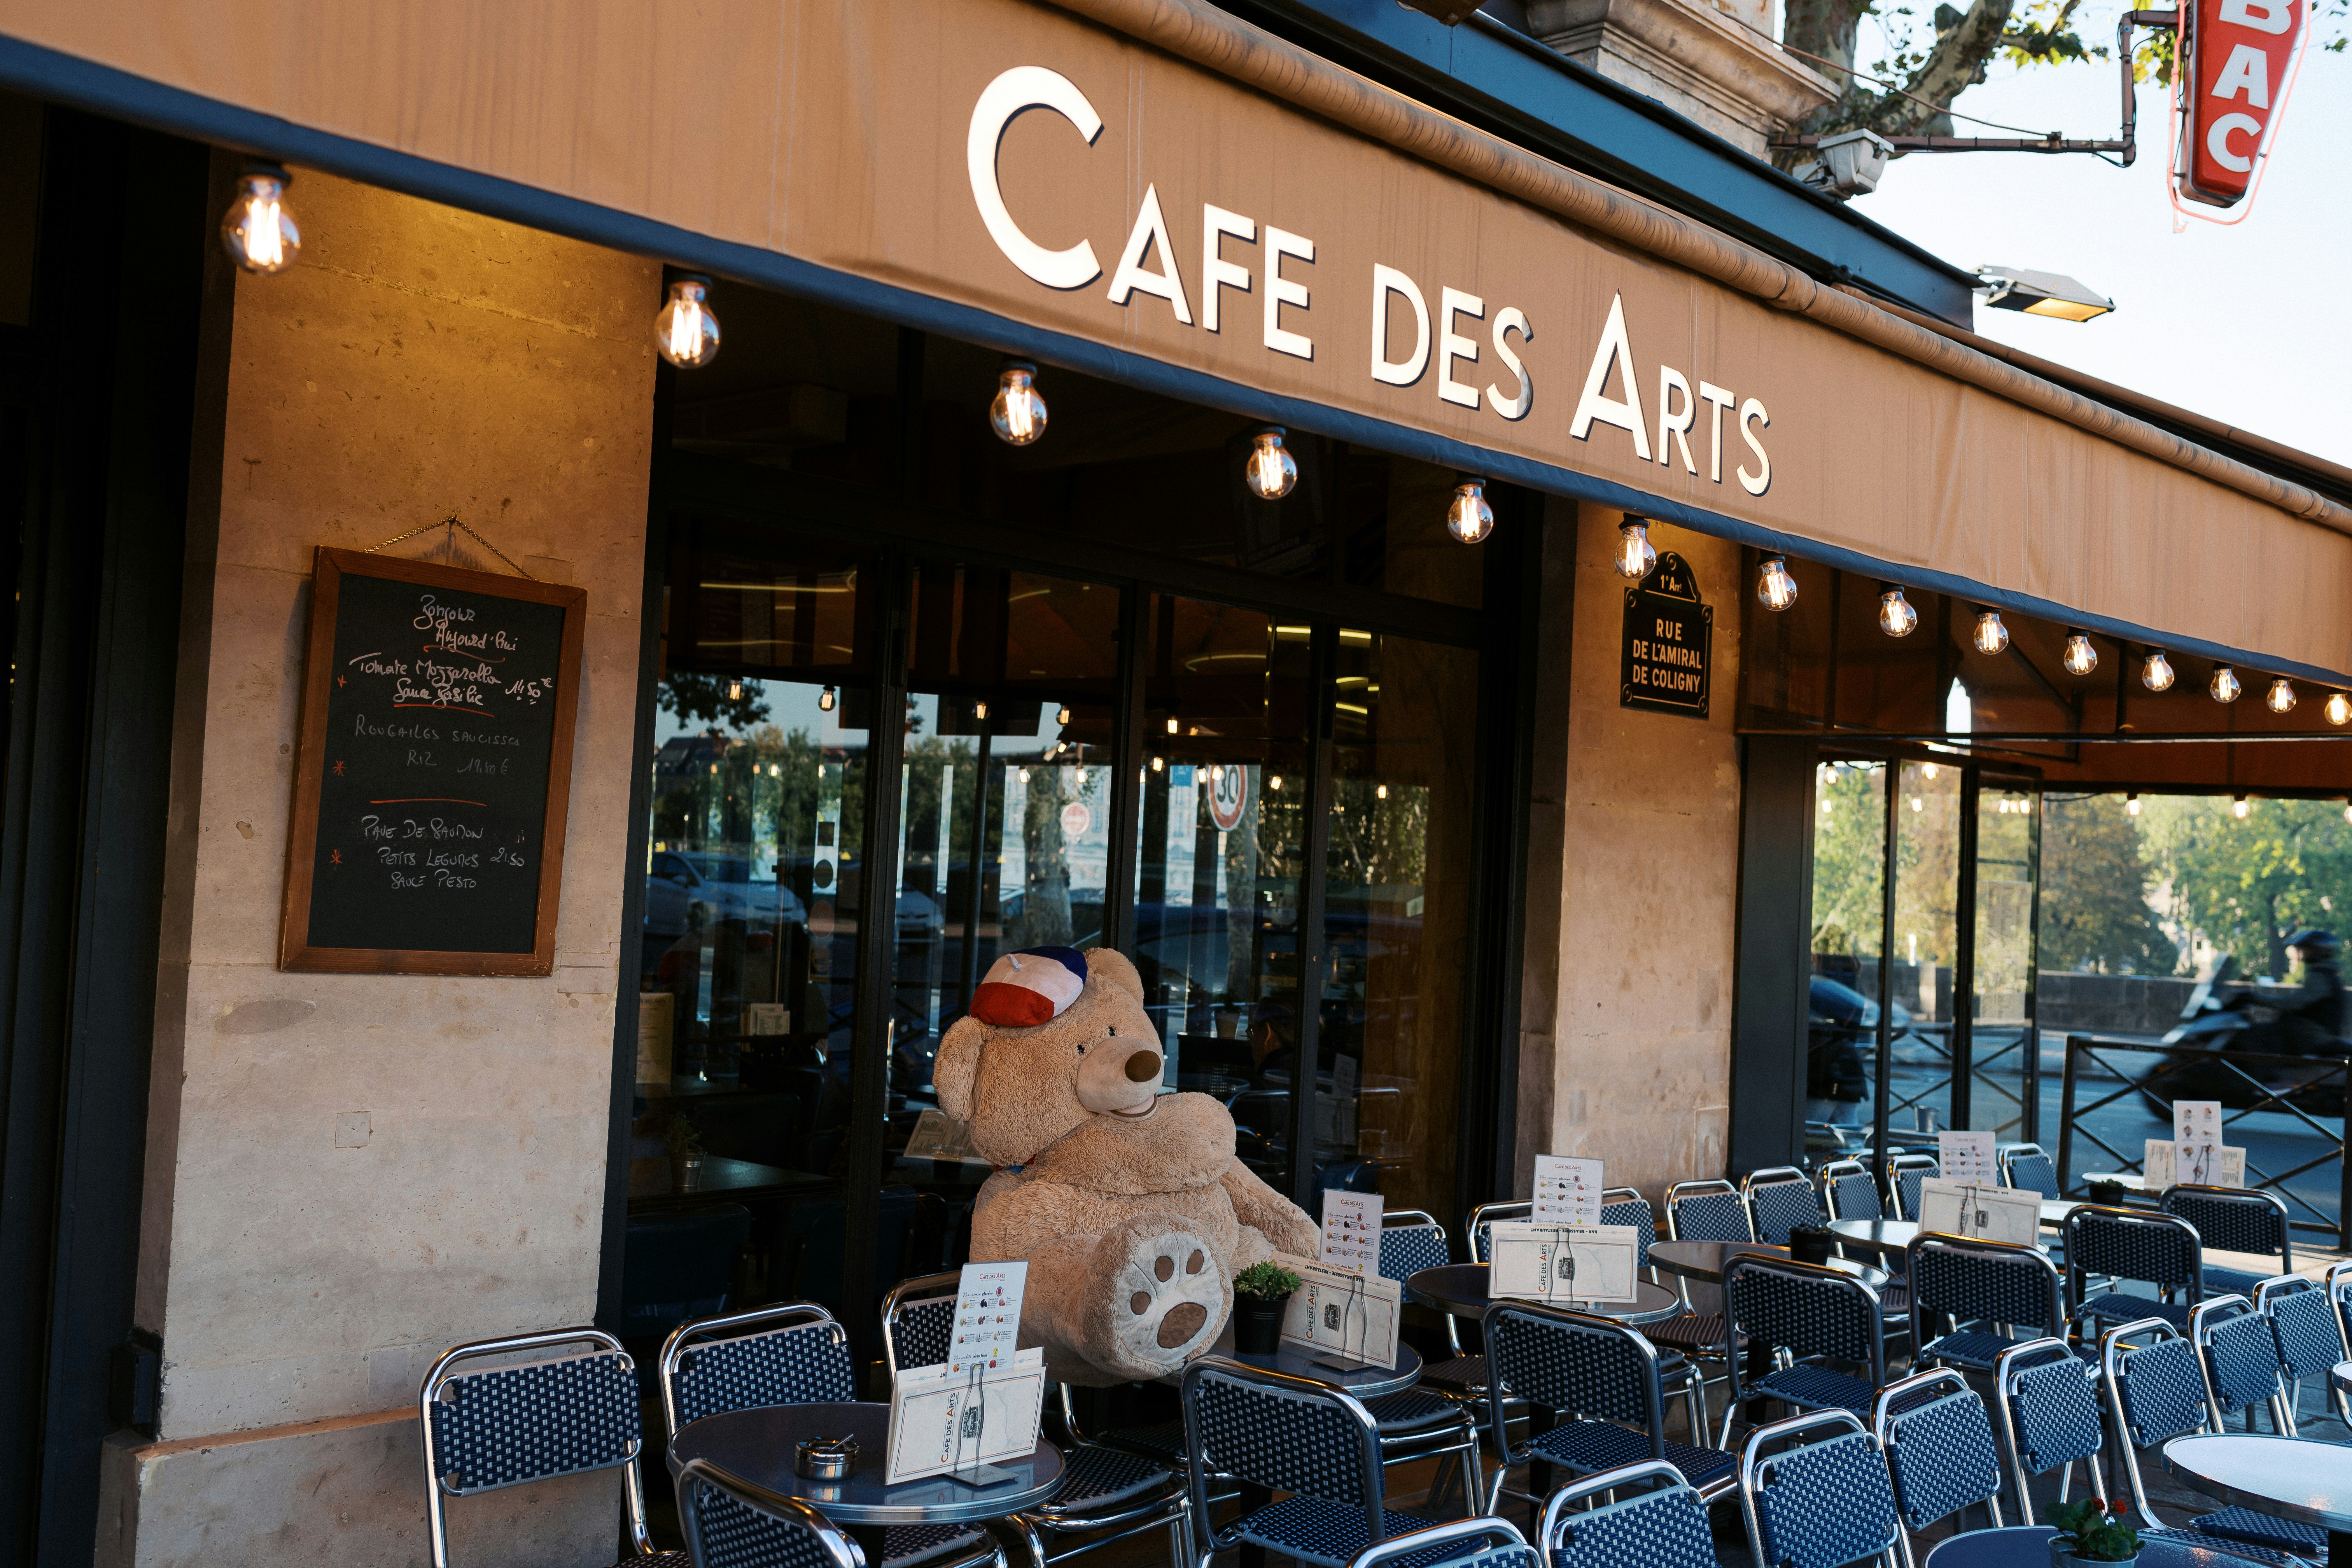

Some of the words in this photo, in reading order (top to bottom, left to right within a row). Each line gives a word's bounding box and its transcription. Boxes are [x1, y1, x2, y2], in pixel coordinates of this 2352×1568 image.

[968, 65, 1315, 361] CAFE
[1371, 262, 1534, 421] DES
[1569, 289, 1772, 496] ARTS
[1656, 619, 1682, 641] RUE
[1633, 639, 1648, 660] DE
[1652, 642, 1702, 669] L'AMIRAL
[349, 652, 408, 675] Tomate
[416, 659, 502, 688] Mozzarella
[1633, 664, 1648, 685] DE
[1652, 668, 1701, 693] COLIGNY
[393, 677, 432, 703] Sauce
[407, 749, 437, 766] RIZ
[361, 815, 397, 840] PAVE
[403, 819, 426, 838] DE
[430, 818, 483, 839] SAUMON
[377, 846, 416, 866] PETITS
[426, 848, 479, 867] LEGUMES
[391, 872, 426, 889] SAUCE
[434, 868, 476, 888] PESTO
[1304, 1264, 1329, 1274] RESTAURANT
[1332, 1271, 1352, 1280] BRASSERIE
[1307, 1285, 1316, 1305] ARTS
[941, 1438, 950, 1463] CAFE
[946, 1393, 955, 1417] ARTS
